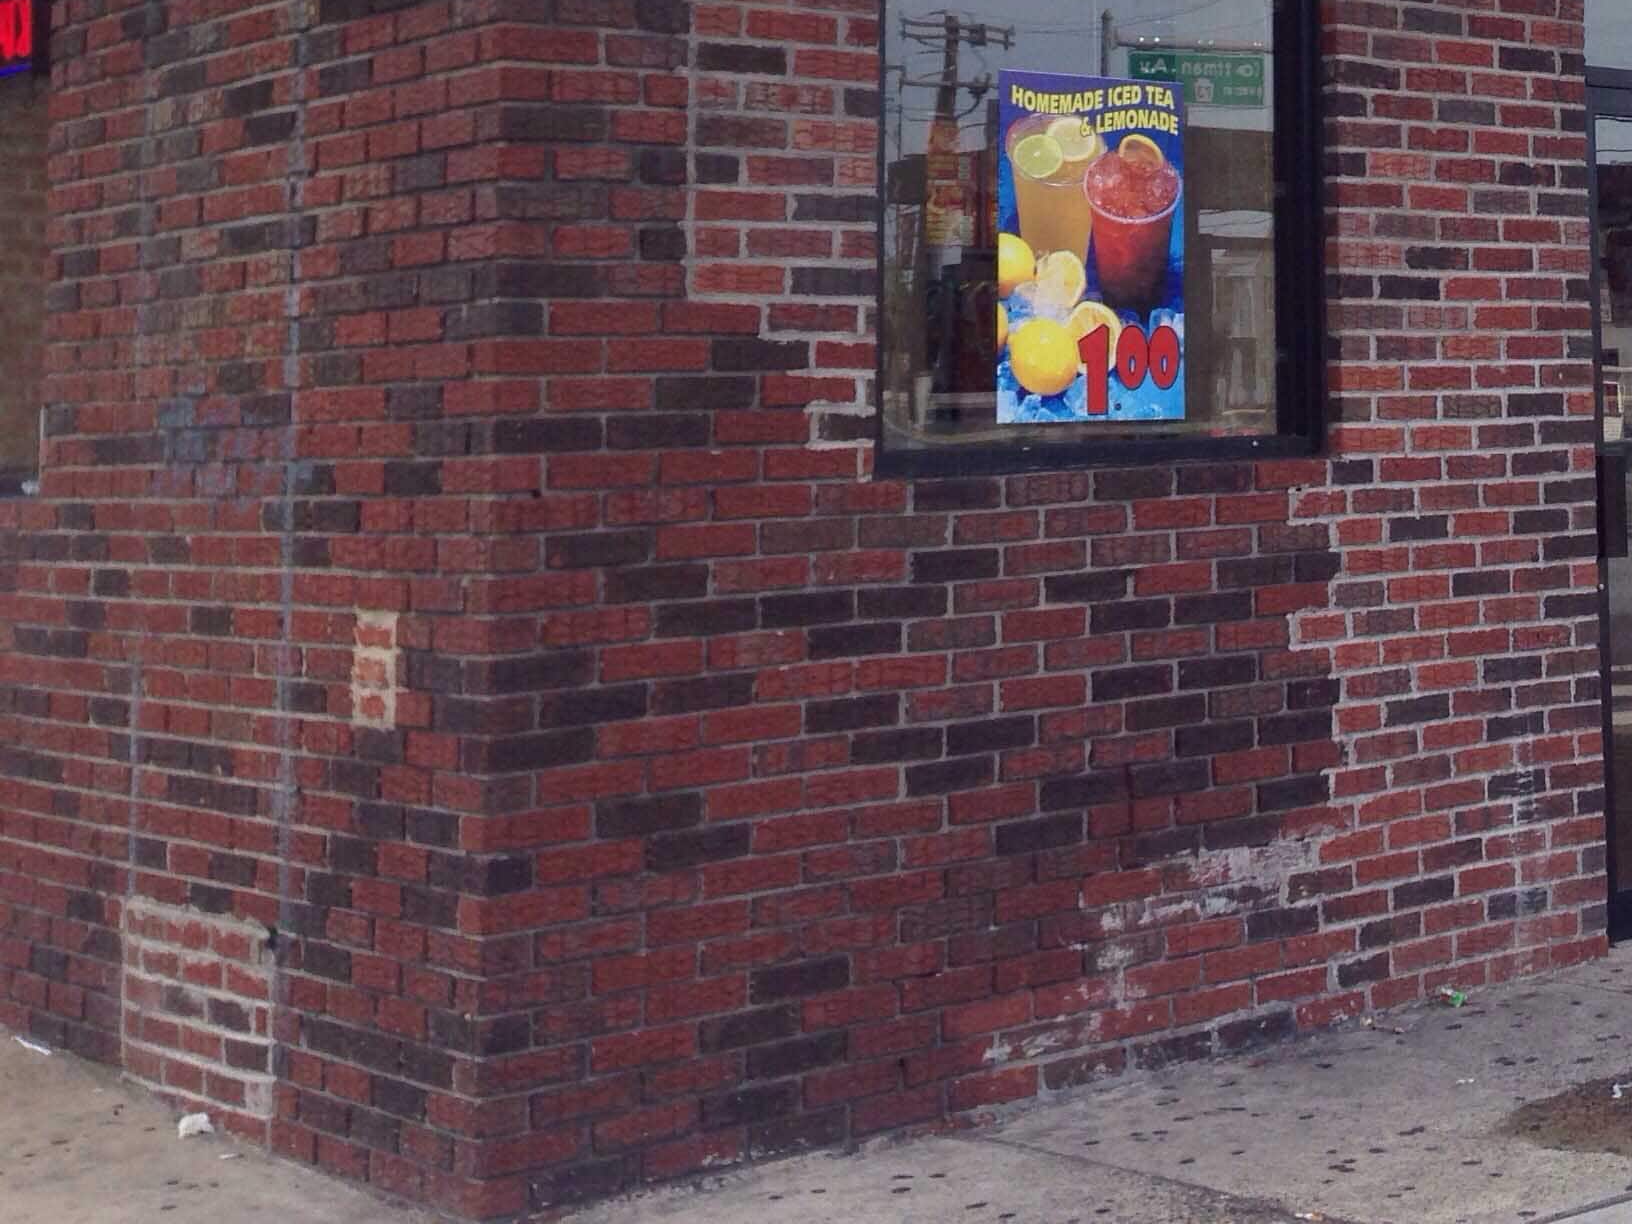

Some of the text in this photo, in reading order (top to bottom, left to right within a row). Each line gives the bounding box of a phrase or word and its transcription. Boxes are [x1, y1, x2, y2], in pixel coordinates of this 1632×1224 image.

[1011, 84, 1174, 114] HOMEMADE ICED TEA
[1080, 109, 1178, 136] & LEMONADE
